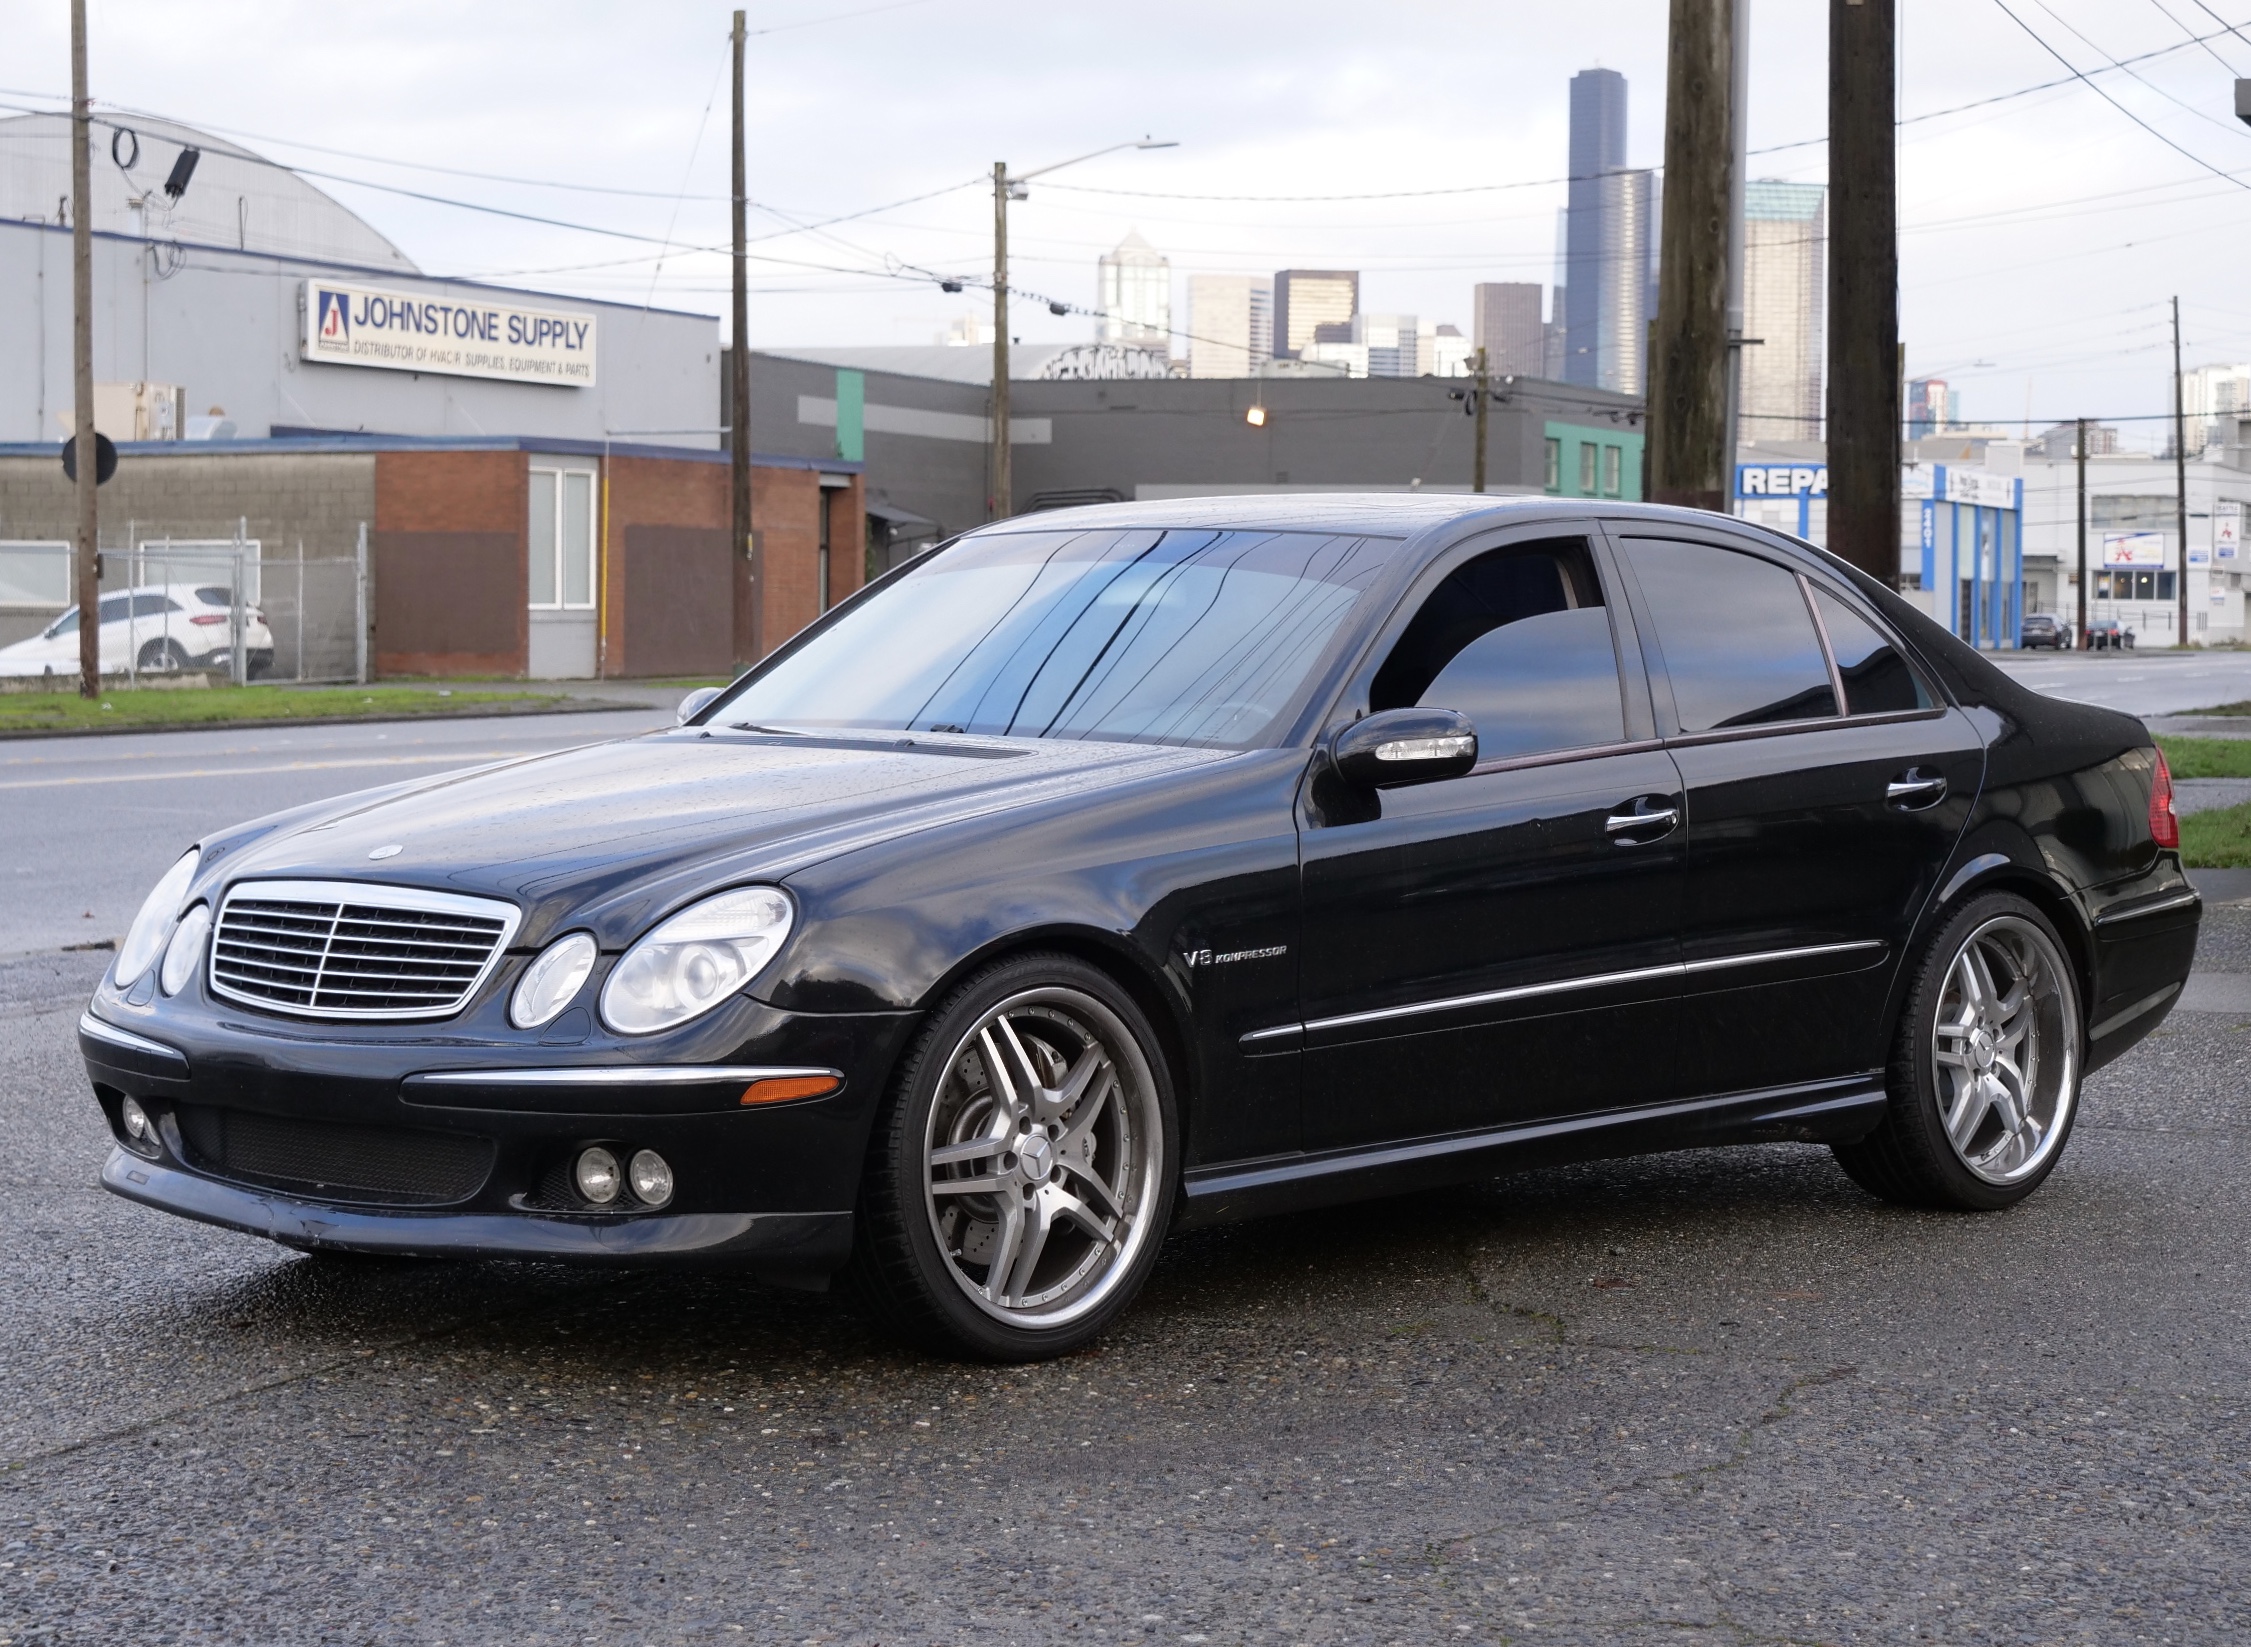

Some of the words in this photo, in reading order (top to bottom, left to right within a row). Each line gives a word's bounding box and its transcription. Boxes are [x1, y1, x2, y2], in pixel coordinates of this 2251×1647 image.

[325, 308, 339, 336] J
[355, 296, 499, 341] JOHNSTONE
[508, 314, 589, 351] SUPPLY
[354, 339, 414, 360] DISTRIBUTOR
[416, 346, 428, 362] OF
[509, 355, 556, 375] EQUIPMENT
[565, 362, 590, 377] PARTS
[1183, 949, 1213, 968] V8
[1215, 945, 1287, 964] KOMPRESSOR
